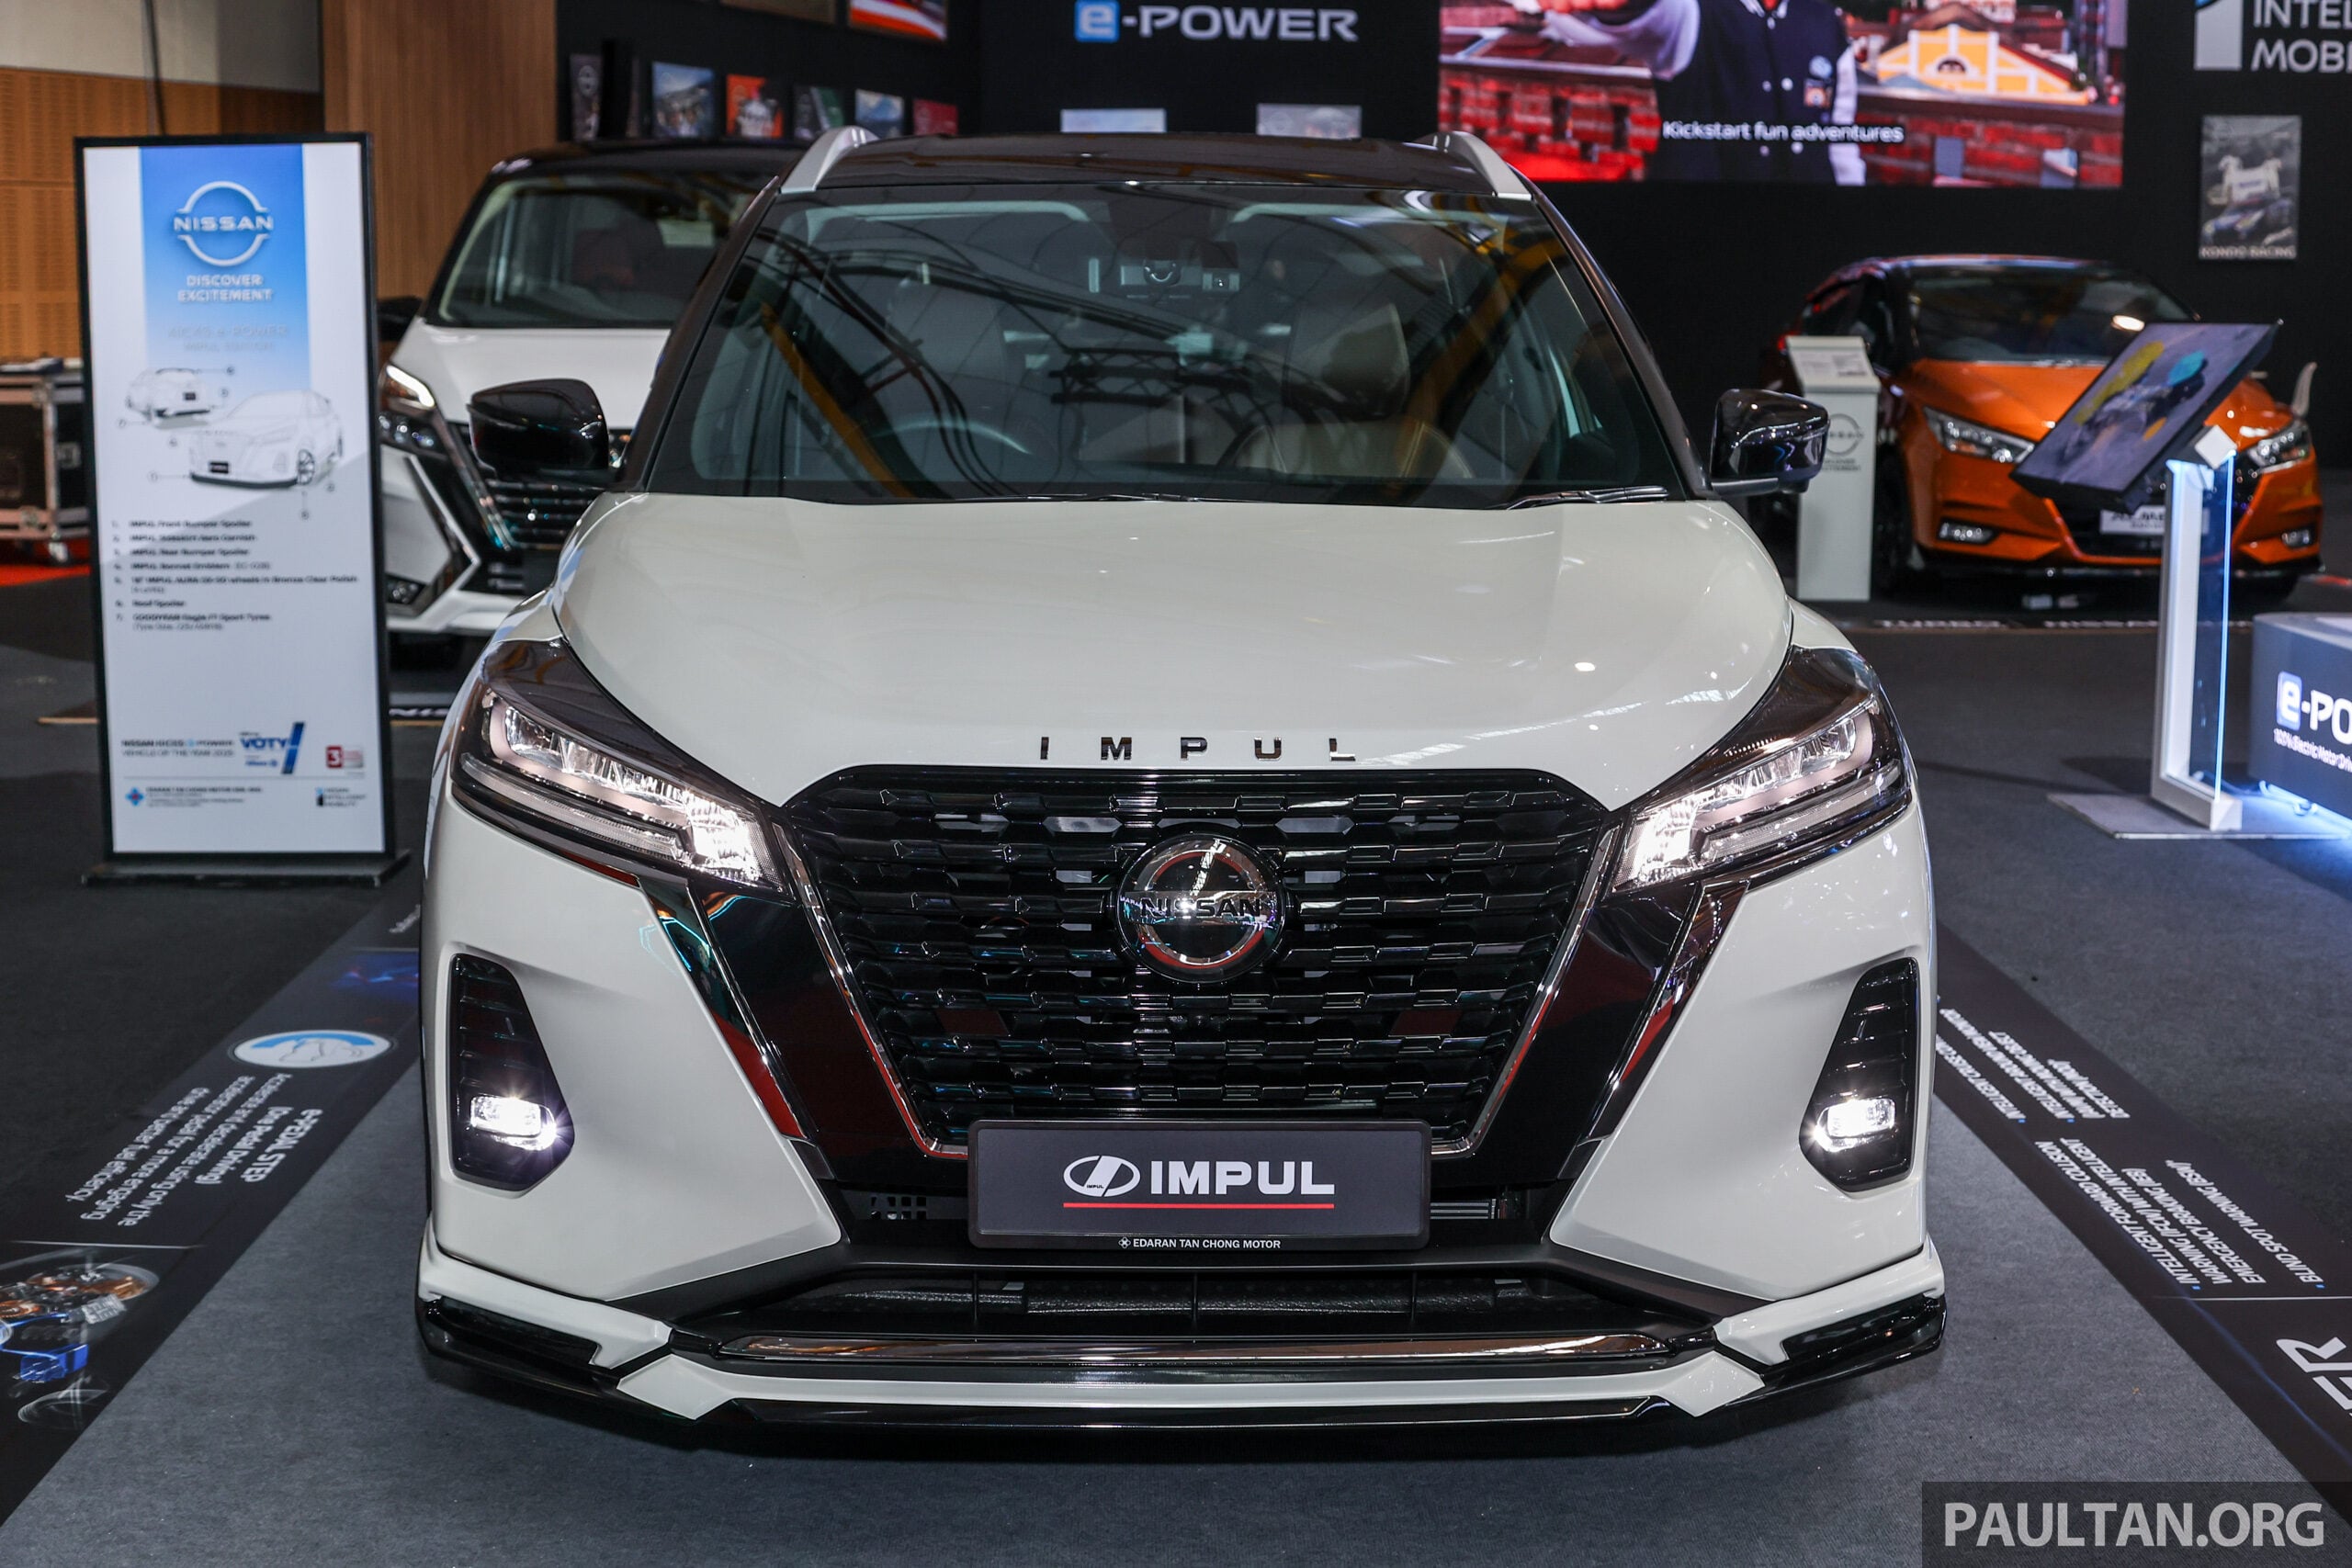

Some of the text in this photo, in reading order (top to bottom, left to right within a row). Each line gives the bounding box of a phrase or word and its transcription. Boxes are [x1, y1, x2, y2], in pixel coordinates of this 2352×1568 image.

[1077, 2, 1359, 43] e-POWER
[1663, 120, 1905, 142] Kickstart fun adventures
[173, 216, 275, 232] NISSAN
[186, 274, 264, 288] DISCOVER
[177, 288, 273, 303] EXCITEMENT
[1040, 736, 1356, 761] IMPUL
[1139, 897, 1262, 919] NISSAN
[233, 1125, 273, 1149] Pedal
[131, 1156, 168, 1178] more
[195, 1150, 249, 1184] Driving)
[241, 1153, 286, 1182] STEP
[2060, 1138, 2127, 1186] INTELLIGENT
[151, 1166, 192, 1189] using
[1150, 1160, 1335, 1196] IMPUL
[81, 1179, 143, 1219] engaging
[131, 1190, 168, 1210] only
[2113, 1187, 2152, 1209] WITH
[2143, 1188, 2201, 1224] BRAKING
[2197, 1187, 2258, 1226] WARNING
[118, 1211, 150, 1225] the
[2035, 1142, 2199, 1283] INTELLIGENT FORWARD COLLISION
[1133, 1237, 1282, 1249] EDARAN TAN CHONG MOTOR
[2244, 1227, 2288, 1252] SPOT
[2168, 1238, 2232, 1283] WARNING
[2186, 1225, 2266, 1282] EMERGENCY
[2276, 1254, 2323, 1282] BLIND
